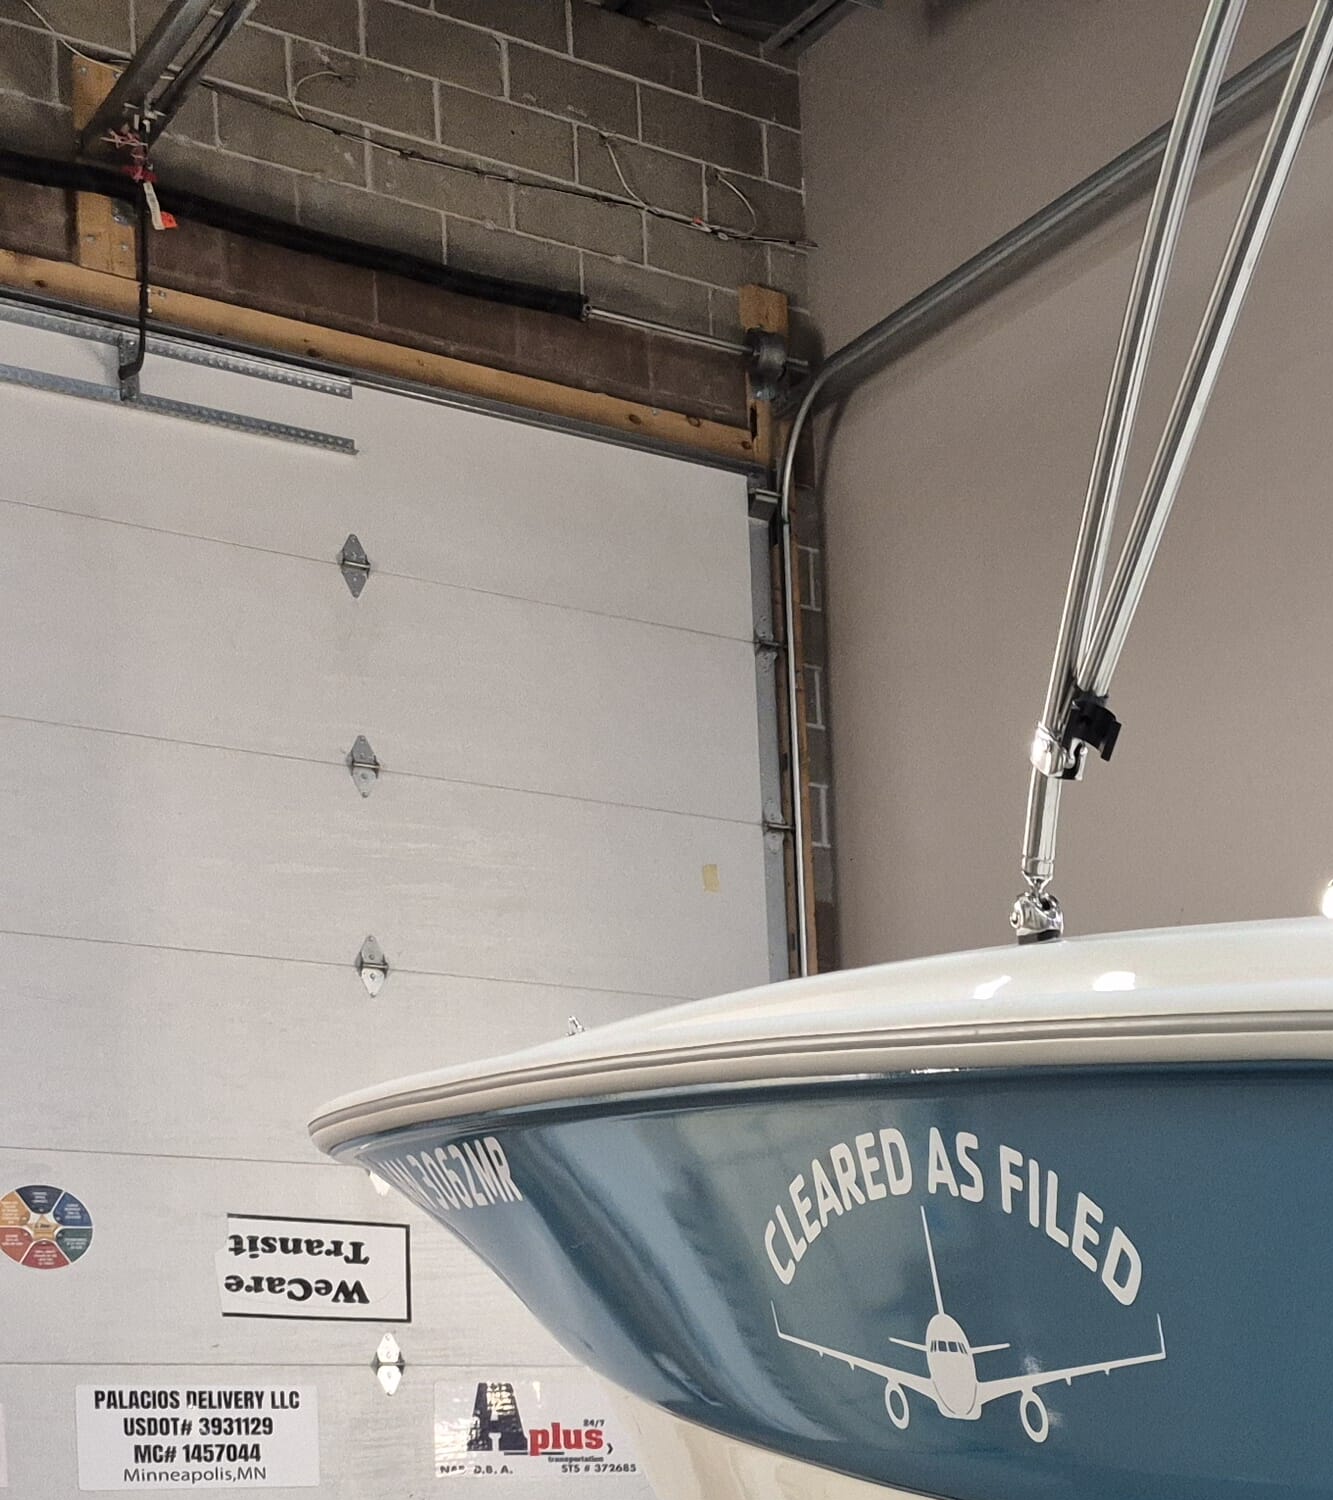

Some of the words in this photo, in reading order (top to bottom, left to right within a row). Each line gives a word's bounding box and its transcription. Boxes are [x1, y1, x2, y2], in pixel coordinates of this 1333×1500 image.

[763, 1127, 913, 1286] CLEARED
[927, 1126, 985, 1204] AS
[999, 1144, 1143, 1306] FILED
[227, 1234, 371, 1265] Transit
[223, 1274, 371, 1305] WeCare
[94, 1390, 181, 1410] PALACIOS
[185, 1390, 265, 1410] DELIVERY
[270, 1390, 300, 1410] LLC
[123, 1417, 193, 1437] USDOT#
[198, 1417, 274, 1436] 3931129
[133, 1444, 178, 1464] MC#
[182, 1443, 262, 1463] 1457044
[123, 1465, 267, 1484] Minneapolis,MN
[594, 1463, 637, 1474] 372685
